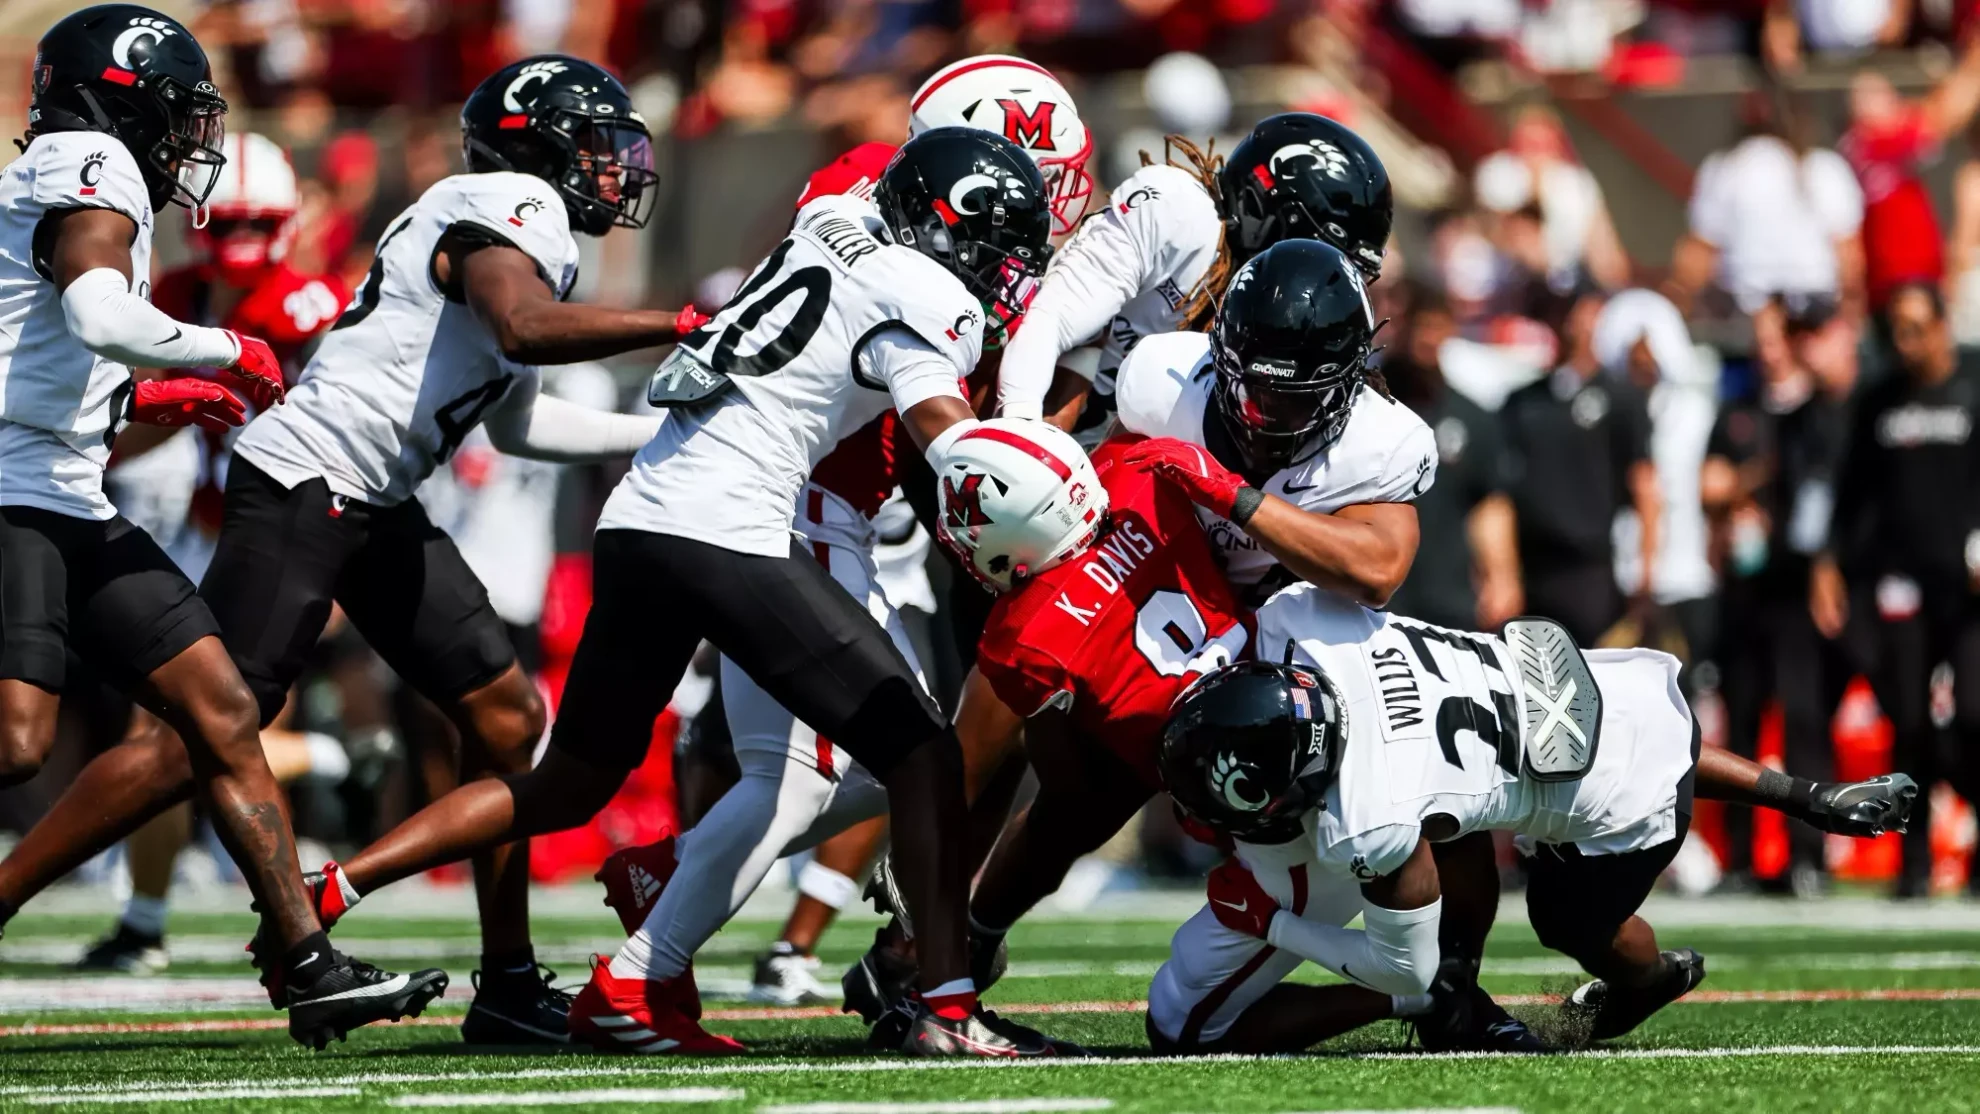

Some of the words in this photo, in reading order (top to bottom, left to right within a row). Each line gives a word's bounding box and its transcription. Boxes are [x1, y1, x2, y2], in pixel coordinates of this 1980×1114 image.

[994, 99, 1057, 151] M
[810, 217, 879, 268] MILLER
[1251, 362, 1295, 378] CINCINNATI
[943, 473, 995, 528] M
[1054, 591, 1103, 627] K.
[1083, 520, 1154, 595] DAVIS
[1371, 648, 1424, 732] WILLIS
[1388, 622, 1519, 778] 27
[627, 863, 646, 909] adidas
